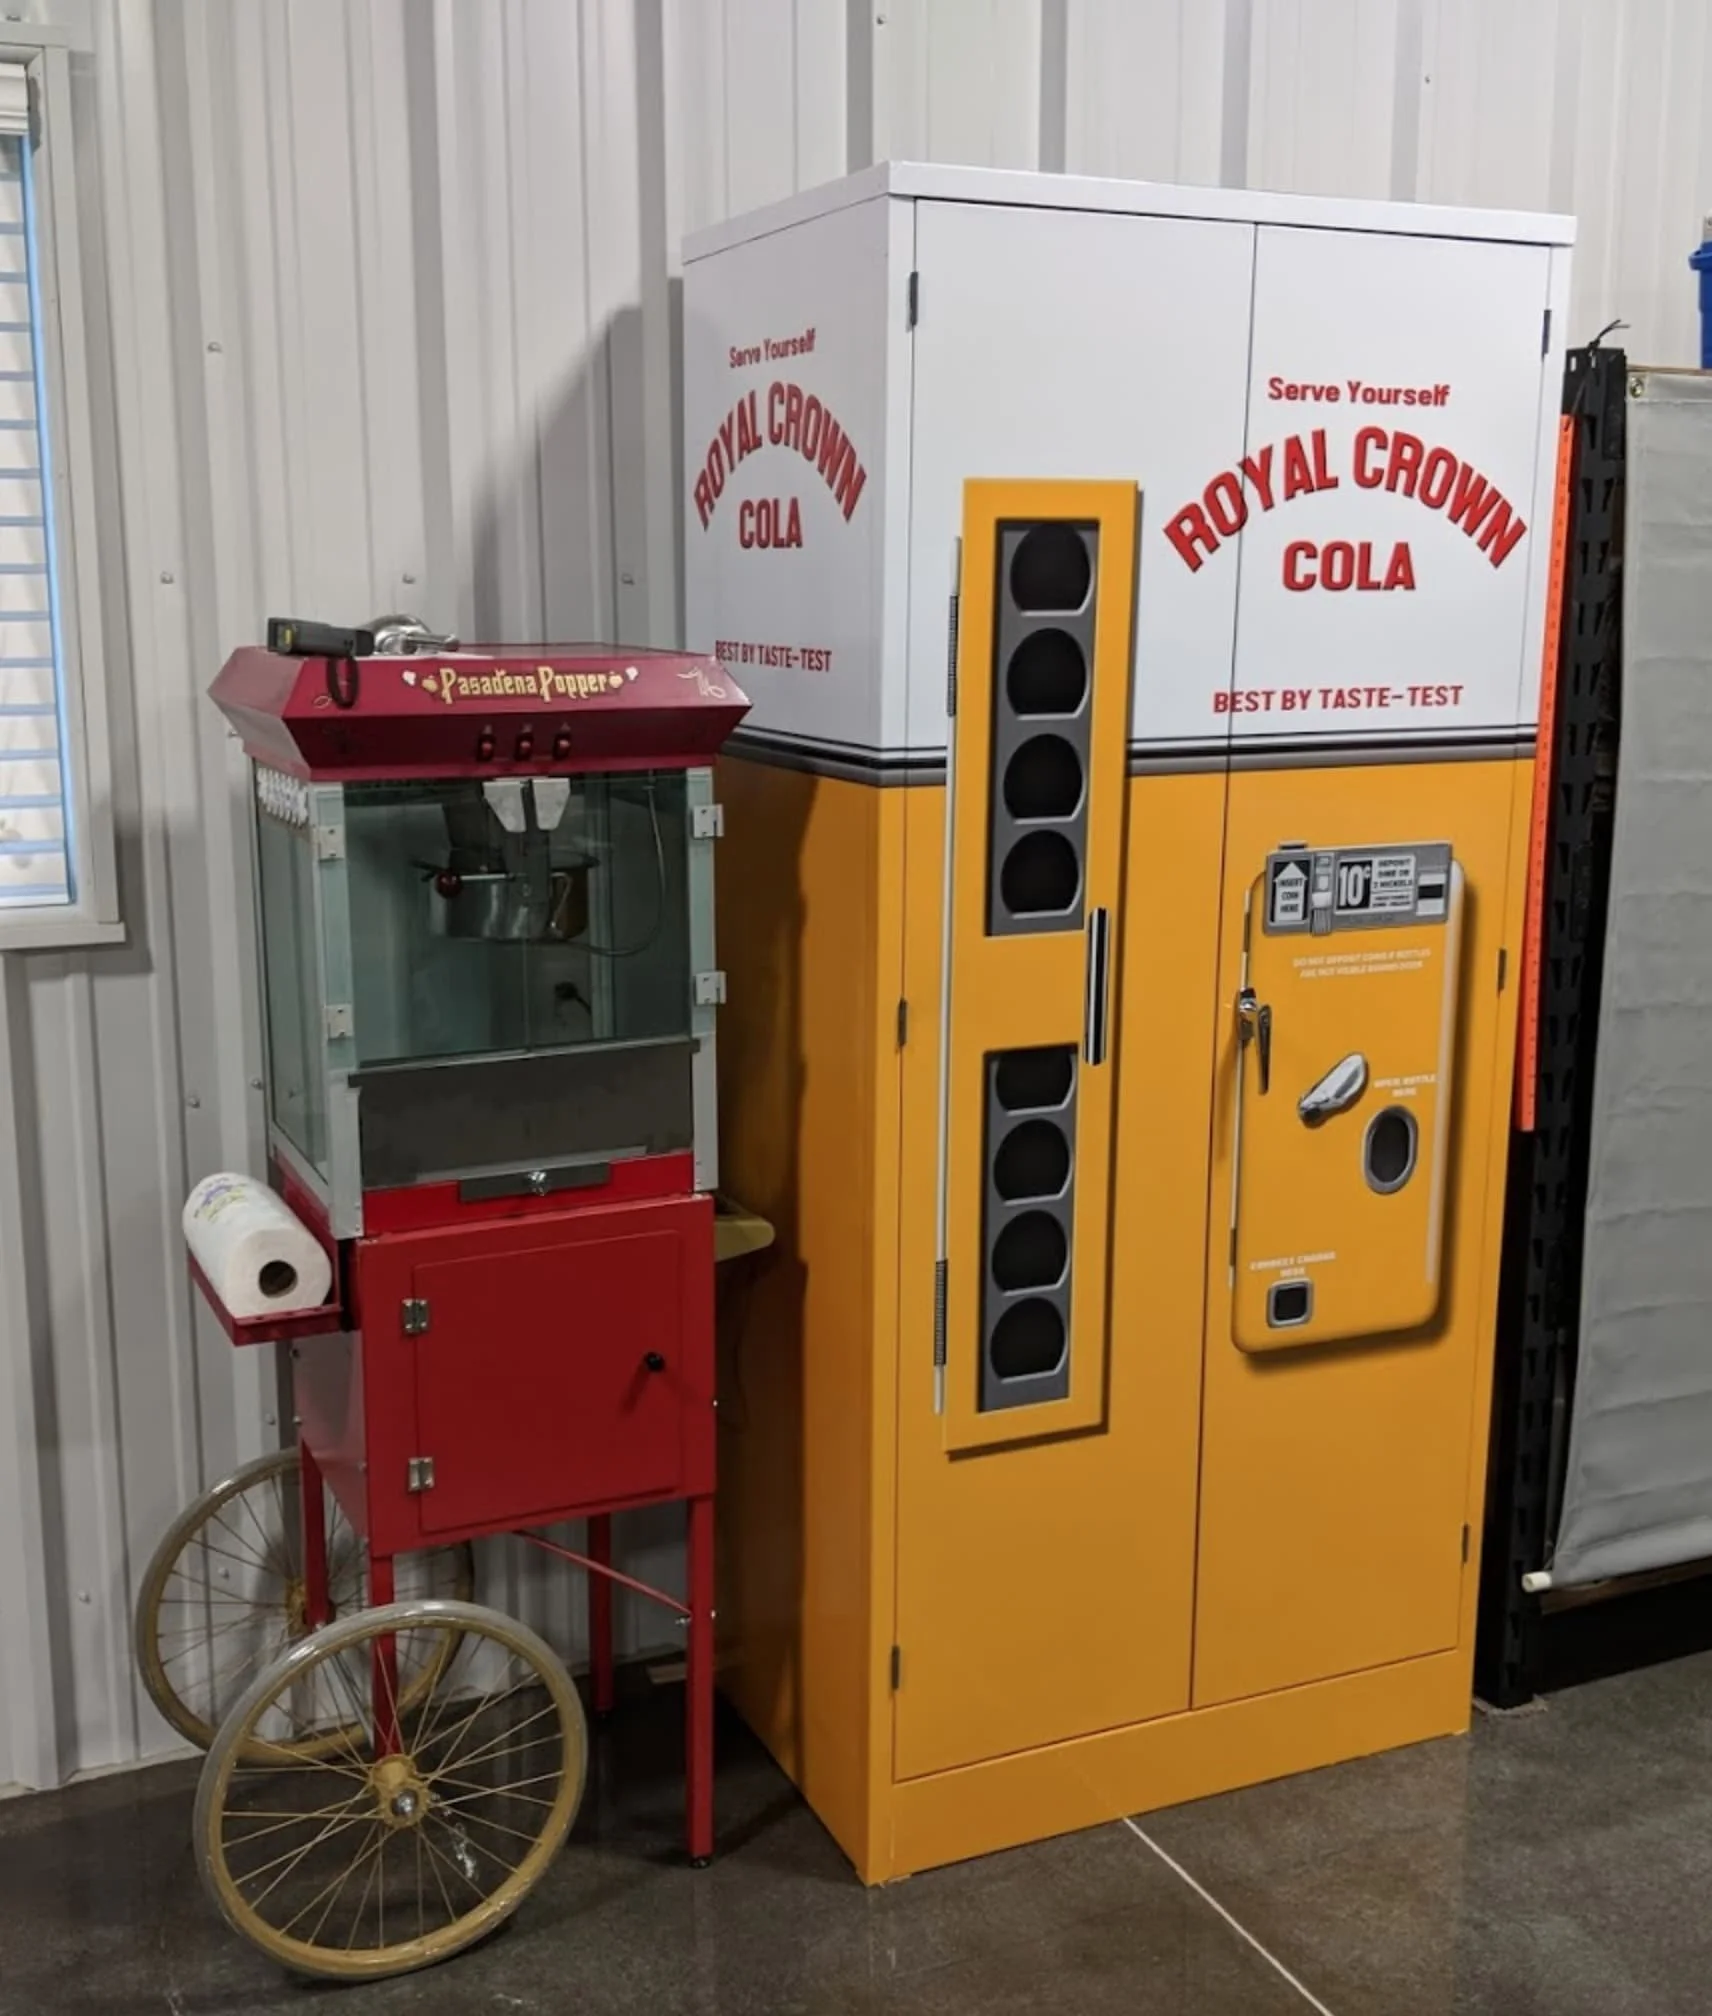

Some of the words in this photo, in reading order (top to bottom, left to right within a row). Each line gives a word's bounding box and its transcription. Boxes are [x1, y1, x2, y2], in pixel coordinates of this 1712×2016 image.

[730, 346, 760, 368] Serve
[763, 328, 816, 361] Yourself
[1268, 377, 1340, 402] Serve
[1347, 380, 1450, 407] Yourself
[694, 390, 763, 532] ROYAL
[768, 381, 867, 523] CROWN
[1162, 428, 1339, 574] ROYAL
[1353, 426, 1528, 570] CROWN
[739, 497, 803, 549] COLA
[1282, 540, 1416, 592] COLA
[715, 640, 739, 662] BEST
[742, 643, 755, 664] BY
[758, 645, 832, 673] TASTE-TEST
[440, 667, 538, 704] Pasadena
[537, 666, 607, 702] Popper
[1213, 690, 1276, 713] BEST
[1280, 689, 1311, 711] BY
[1319, 685, 1463, 709] TASTE-TEST
